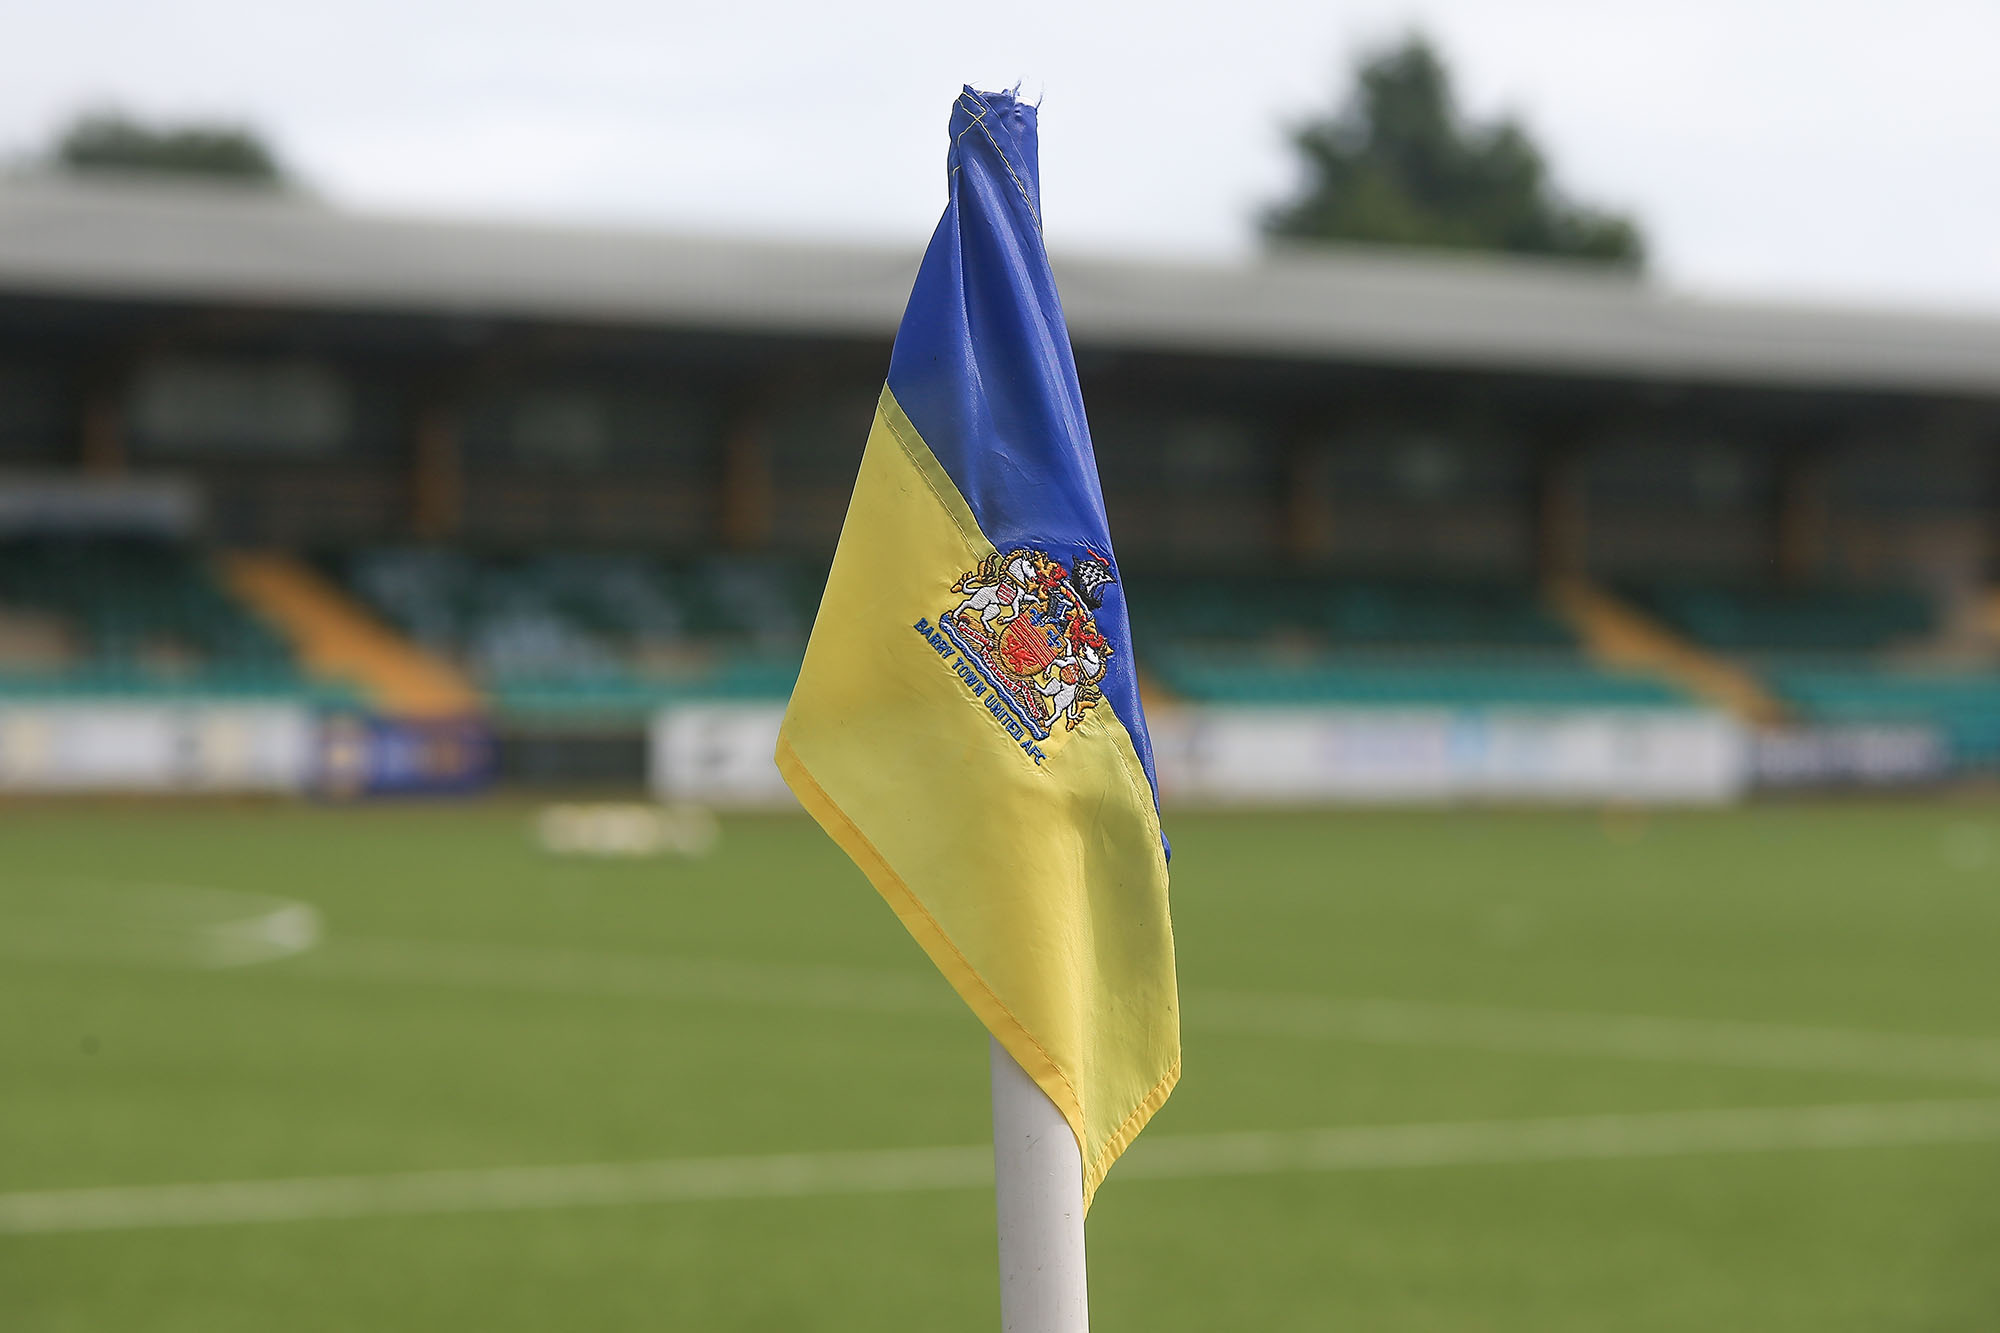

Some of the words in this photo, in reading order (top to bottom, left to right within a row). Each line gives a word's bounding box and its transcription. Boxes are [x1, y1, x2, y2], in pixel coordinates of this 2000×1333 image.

[914, 617, 955, 659] BARRY
[952, 657, 987, 697] TOWN
[984, 694, 1025, 740] UNITED
[1021, 740, 1047, 766] AFC
